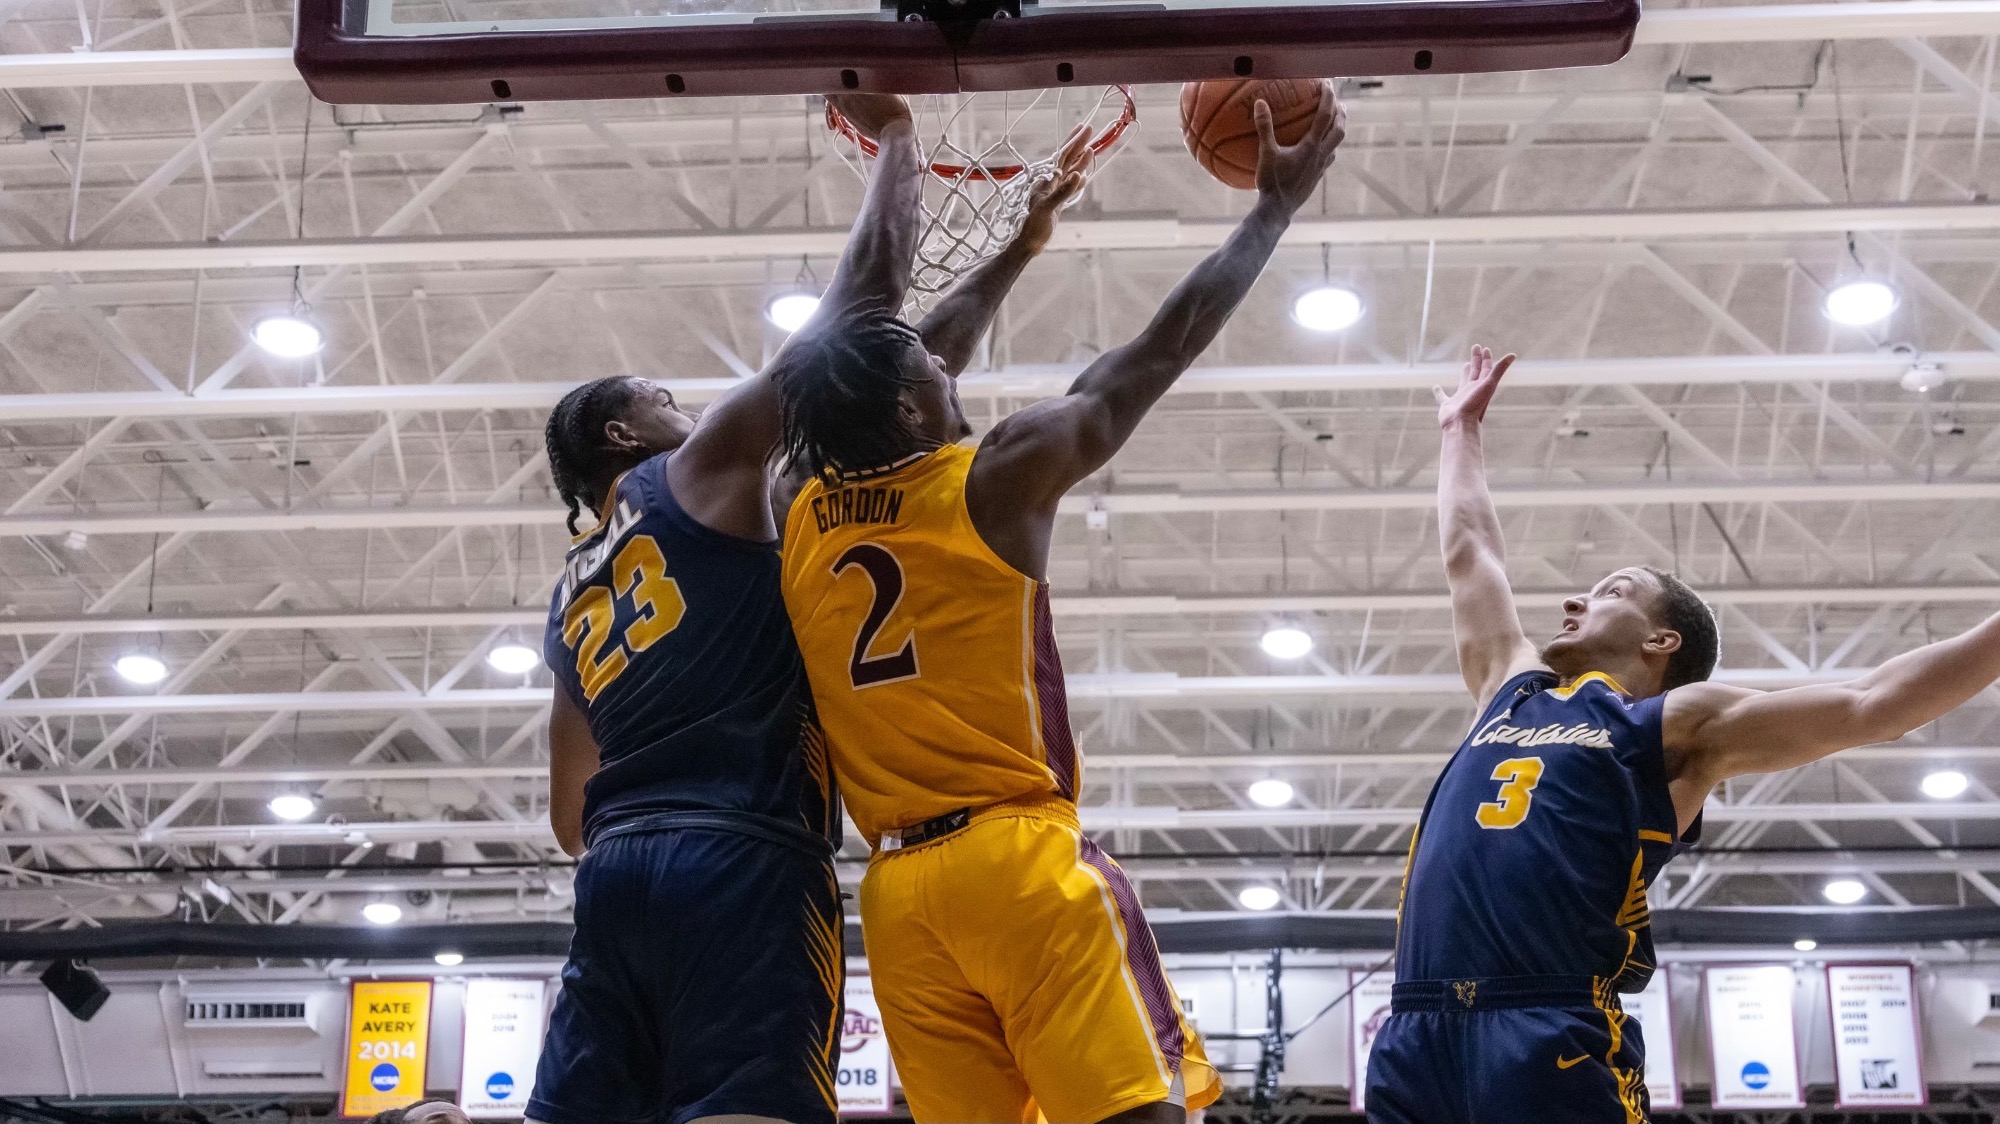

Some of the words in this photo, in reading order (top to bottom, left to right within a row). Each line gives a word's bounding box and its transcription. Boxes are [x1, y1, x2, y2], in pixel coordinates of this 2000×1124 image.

[811, 487, 904, 535] GORDON
[562, 534, 687, 708] 23
[829, 541, 921, 691] 2
[1471, 708, 1614, 748] Canisius
[1475, 757, 1545, 829] 3
[362, 1021, 416, 1032] AVERY
[369, 1002, 411, 1014] KATE
[358, 1040, 416, 1060] 2014
[838, 1068, 876, 1085] 018
